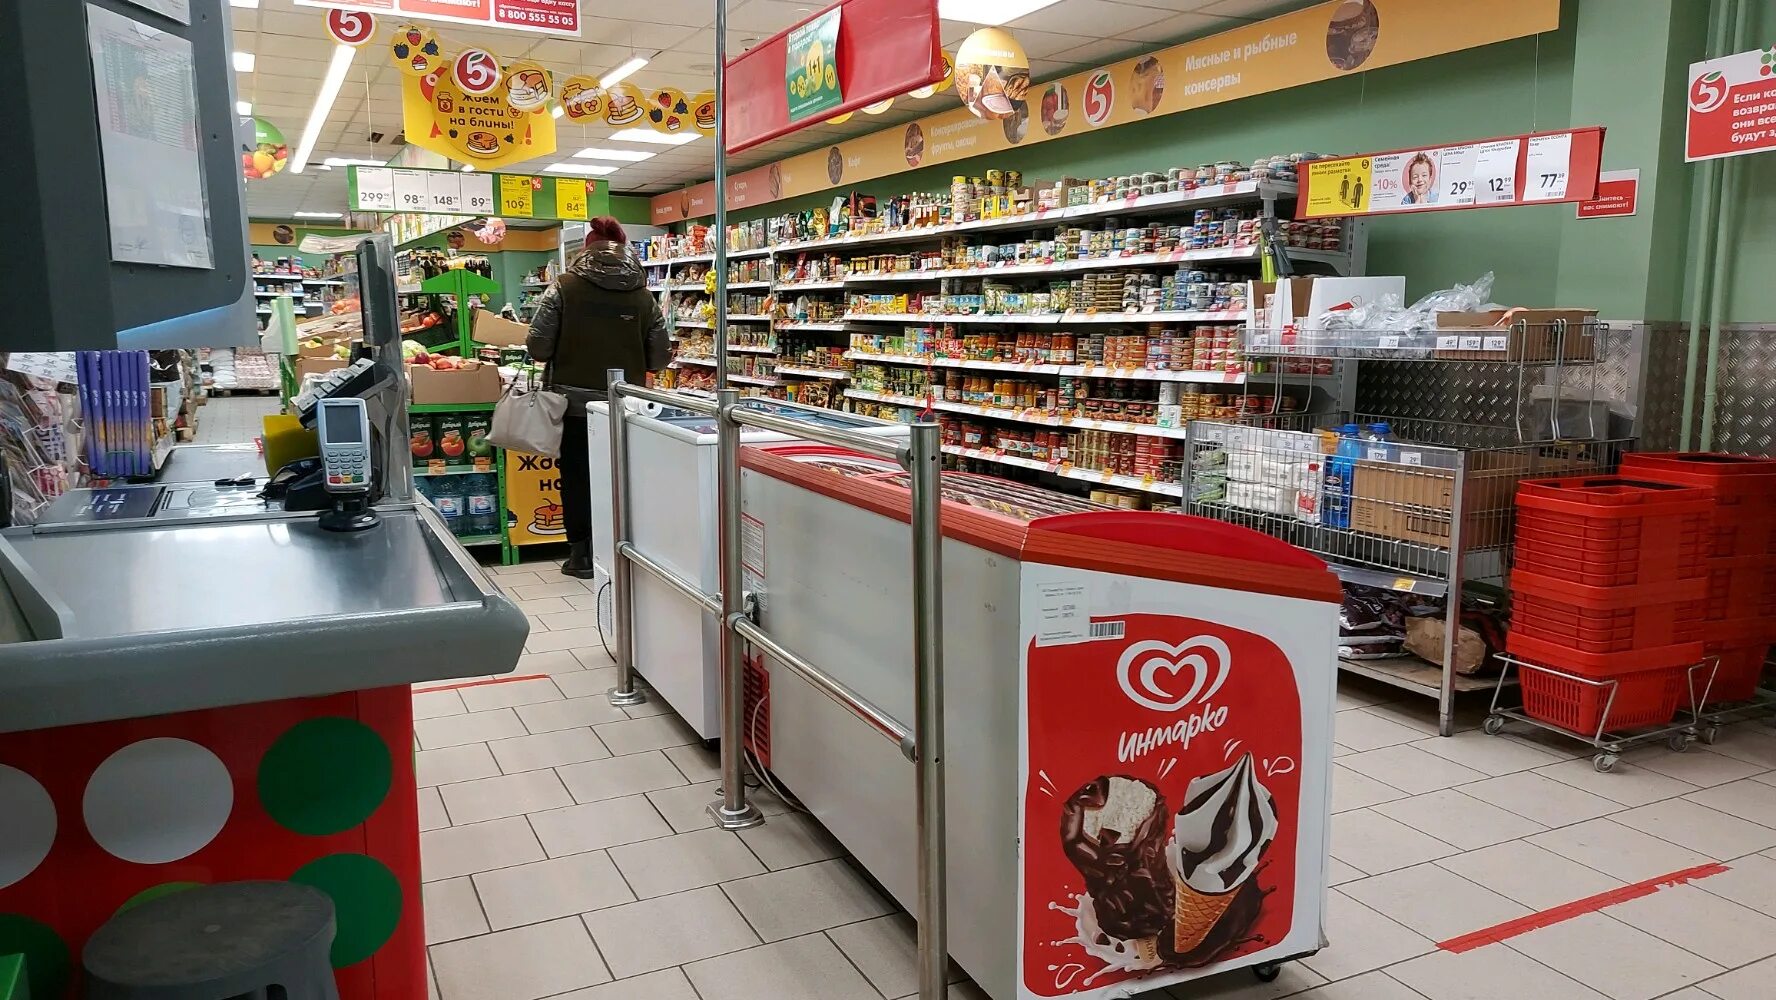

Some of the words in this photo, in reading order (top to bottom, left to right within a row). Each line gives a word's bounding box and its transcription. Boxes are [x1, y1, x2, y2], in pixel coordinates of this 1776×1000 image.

[499, 9, 505, 18] 8
[508, 10, 526, 20] 800
[528, 12, 546, 23] 555
[548, 15, 560, 24] 55
[561, 16, 574, 26] 05
[1185, 54, 1231, 73] Мясные
[1233, 47, 1242, 58] и
[1243, 32, 1298, 62] рыбные
[1184, 72, 1241, 97] консервы
[1733, 92, 1761, 104] Если
[469, 107, 504, 117] гости
[1733, 103, 1776, 117] возвра
[450, 117, 466, 126] на
[470, 117, 514, 129] блины!
[1731, 120, 1755, 130] они
[1757, 116, 1776, 125] все
[1731, 130, 1767, 144] будут
[1450, 181, 1467, 195] 29
[1488, 177, 1504, 192] 12
[1540, 173, 1557, 189] 77
[361, 192, 383, 202] 299
[404, 194, 419, 204] 98
[433, 195, 453, 206] 148
[471, 197, 485, 207] 89
[505, 199, 525, 209] 109
[566, 202, 580, 212] 84
[1118, 702, 1228, 763] Инмарко
